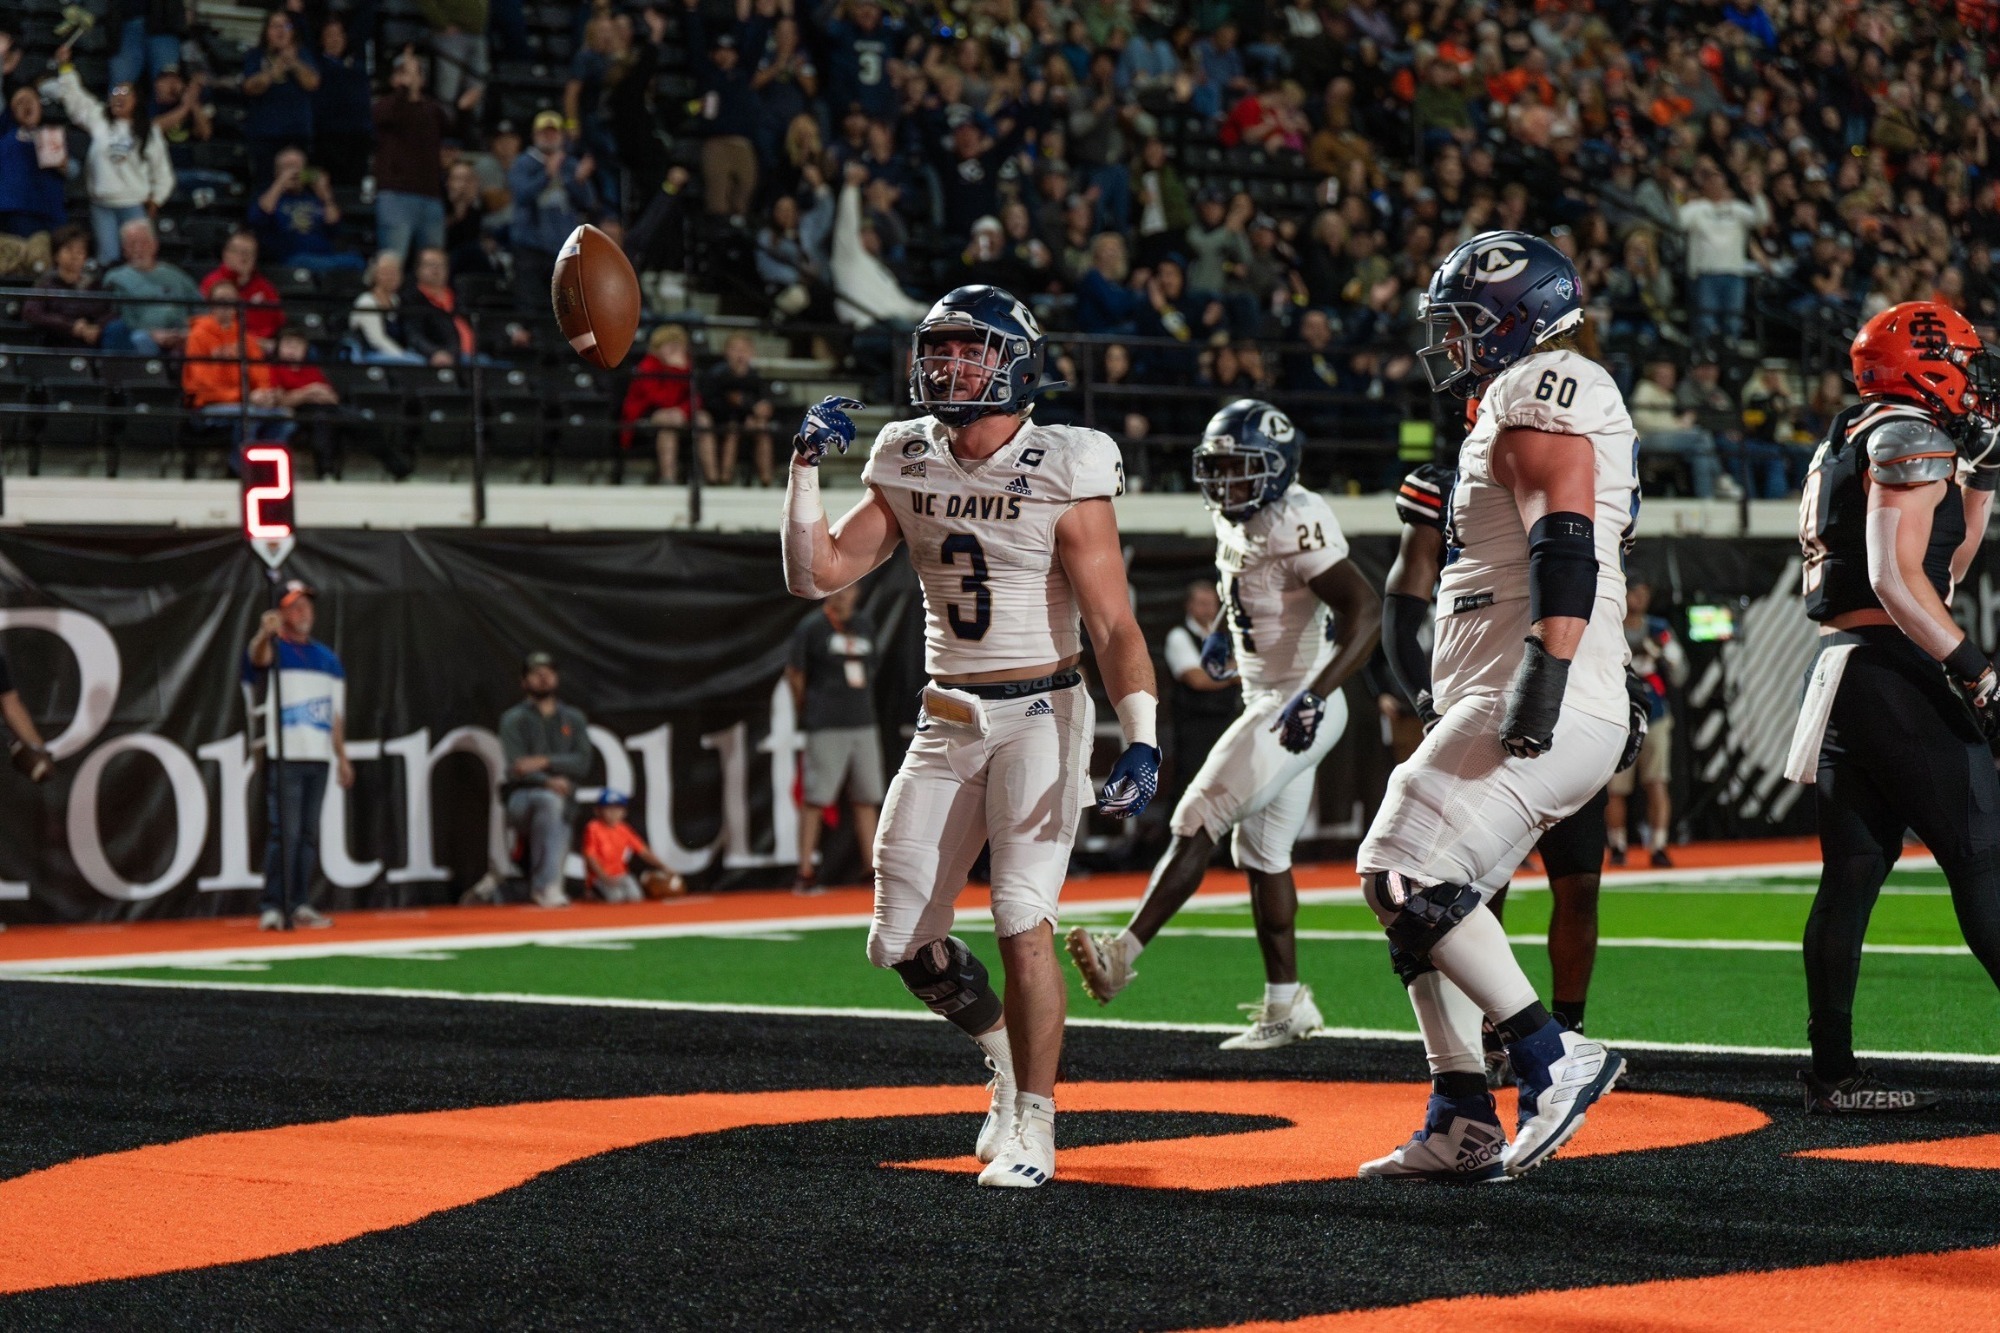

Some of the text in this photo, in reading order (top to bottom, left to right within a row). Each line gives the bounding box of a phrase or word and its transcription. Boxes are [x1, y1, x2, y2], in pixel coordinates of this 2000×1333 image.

[1535, 369, 1578, 409] 60
[1018, 447, 1046, 467] C
[246, 448, 291, 538] 2
[1005, 484, 1033, 496] adidas
[910, 490, 1022, 521] UC DAVIS
[1296, 521, 1327, 550] 24
[939, 532, 992, 643] 3
[1024, 707, 1055, 718] adidas
